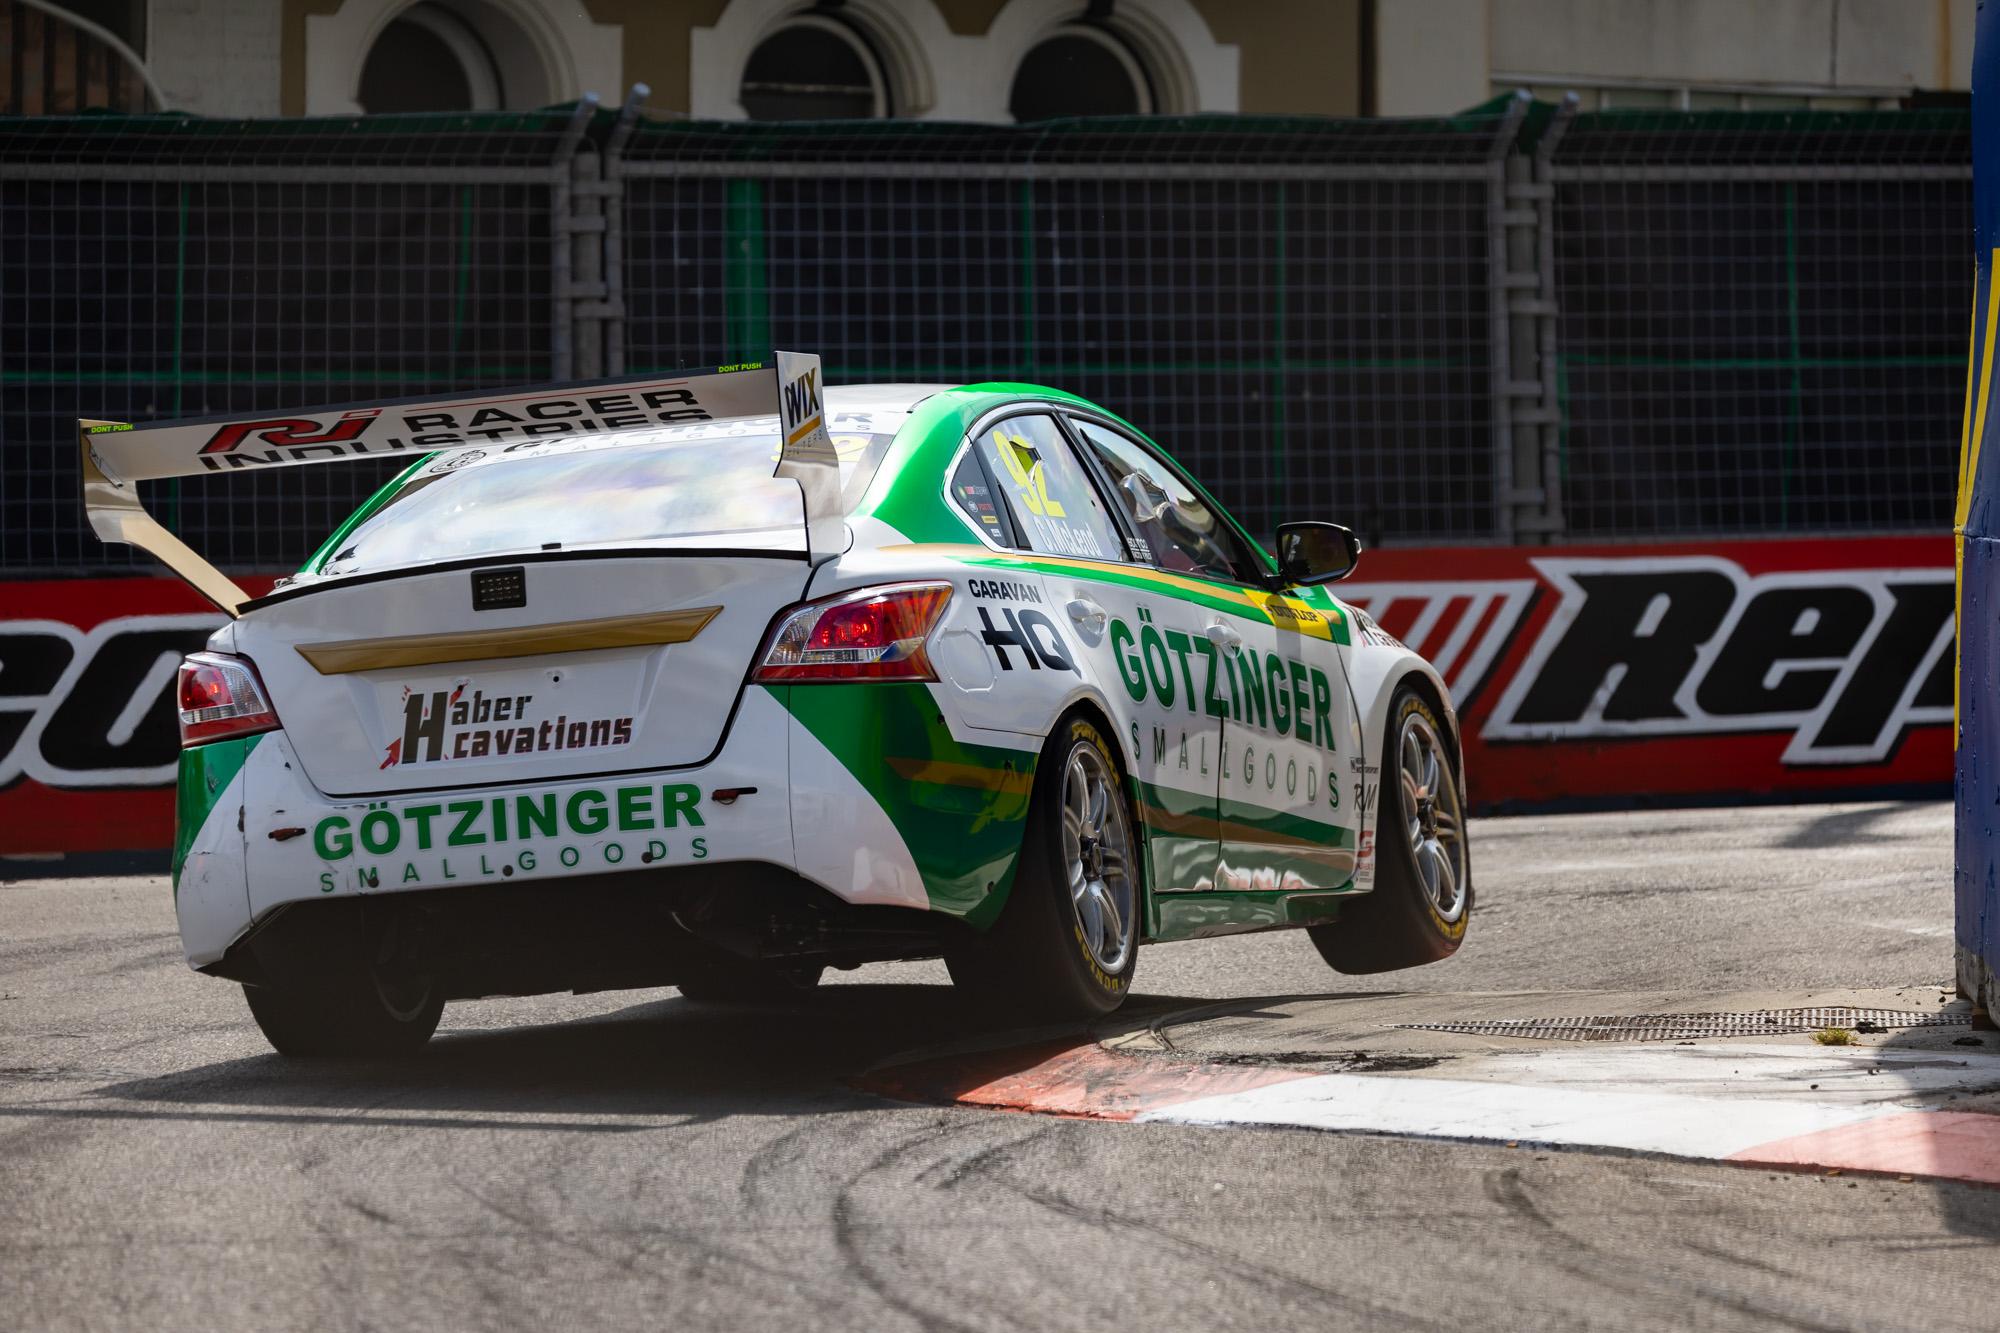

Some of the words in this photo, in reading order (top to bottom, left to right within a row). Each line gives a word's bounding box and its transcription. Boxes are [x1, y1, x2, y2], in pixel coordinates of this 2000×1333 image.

[718, 364, 739, 374] DONT
[741, 362, 762, 371] PUSH
[784, 366, 820, 430] WIX
[91, 425, 112, 434] DONT
[113, 422, 134, 432] PUSH
[403, 389, 699, 433] RACER
[967, 578, 1043, 604] CARAVAN
[976, 606, 1083, 680] HQ
[1109, 606, 1337, 752] GÖTZINGER
[401, 689, 533, 765] Haber
[1131, 718, 1340, 810] SMALLGOODS
[312, 783, 706, 862] GÖTZINGER
[320, 836, 710, 894] SMALLGOODS
